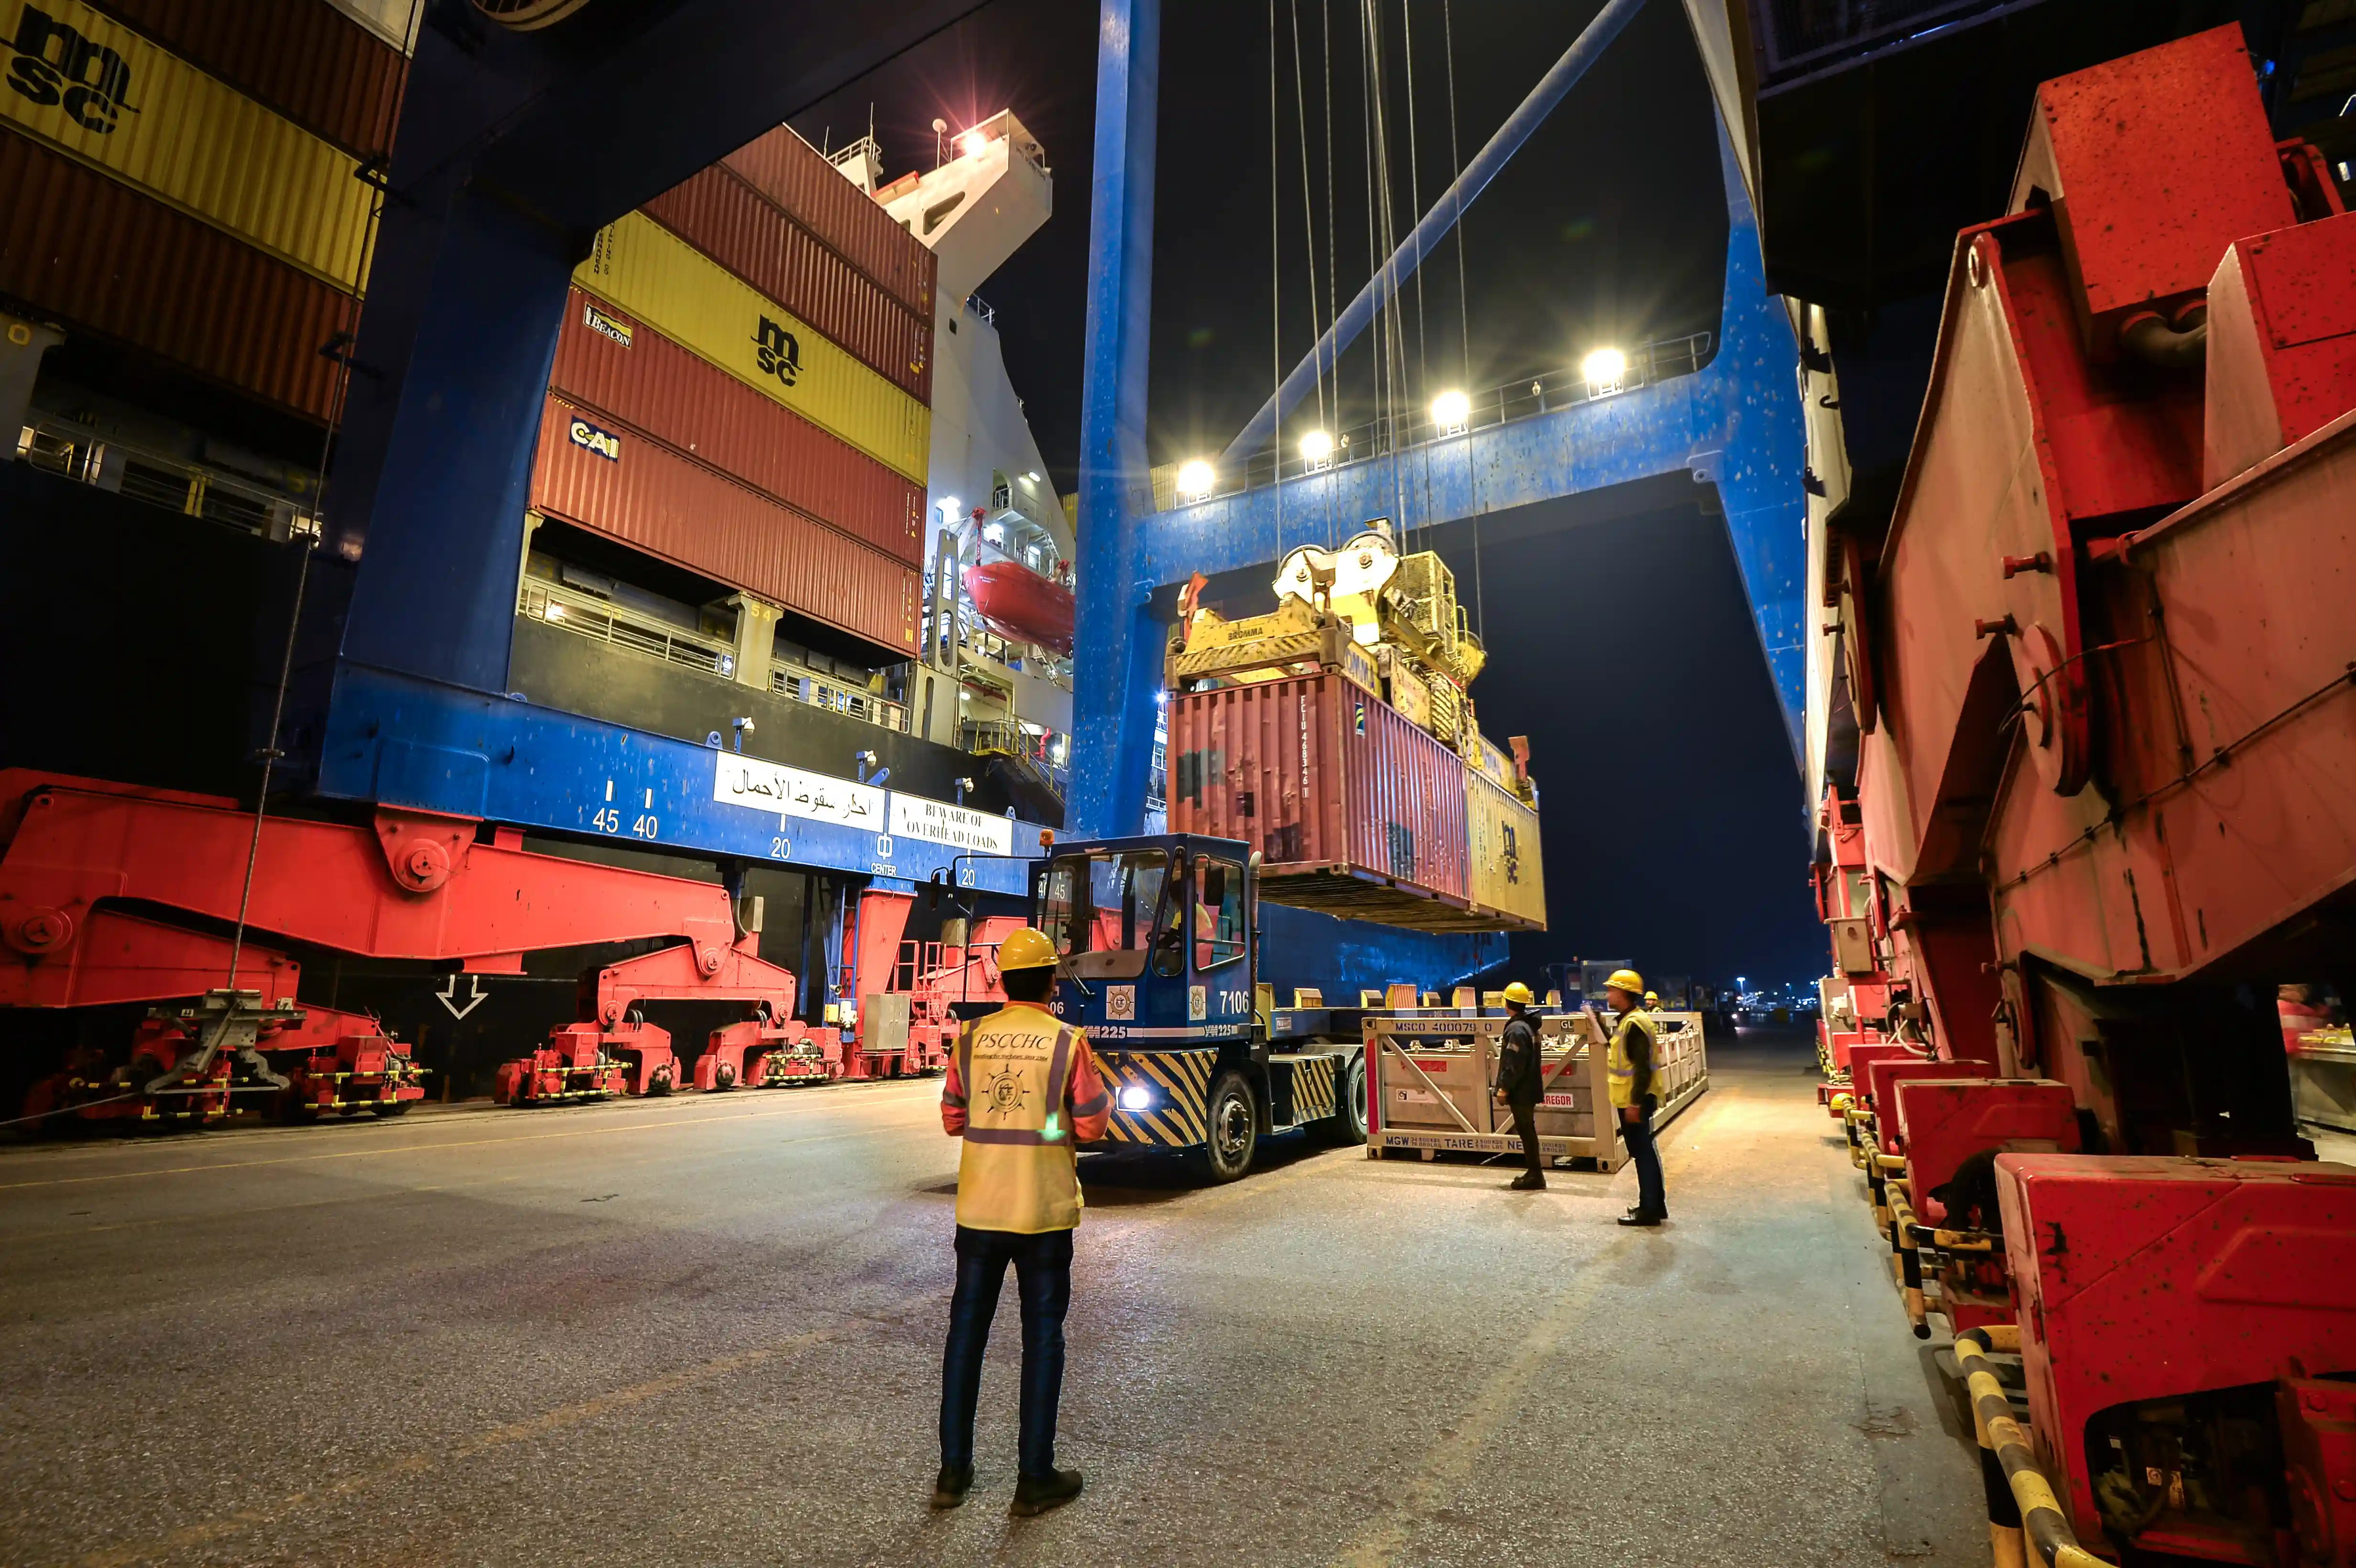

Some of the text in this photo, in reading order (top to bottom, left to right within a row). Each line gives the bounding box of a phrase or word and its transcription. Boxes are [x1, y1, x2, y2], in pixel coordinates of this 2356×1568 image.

[591, 314, 631, 346] BEACON
[571, 422, 619, 458] CAI
[1228, 627, 1264, 641] BROMMA
[593, 808, 619, 833] 45
[926, 804, 984, 827] BEWARE OF
[633, 815, 658, 839] 40
[907, 820, 998, 850] OVERHEAD LOADS
[771, 837, 791, 859] 20
[871, 862, 897, 877] CENTER
[961, 867, 975, 887] 20
[1055, 883, 1065, 899] 45
[1049, 1001, 1064, 1014] 06
[1220, 991, 1249, 1014] 7106
[1432, 1023, 1477, 1032] 400079
[1561, 1020, 1573, 1028] GL
[975, 1033, 1052, 1050] PSCCHC
[1385, 1135, 1409, 1145] MGW
[1444, 1139, 1474, 1148] TARE
[1507, 1140, 1523, 1151] NE
